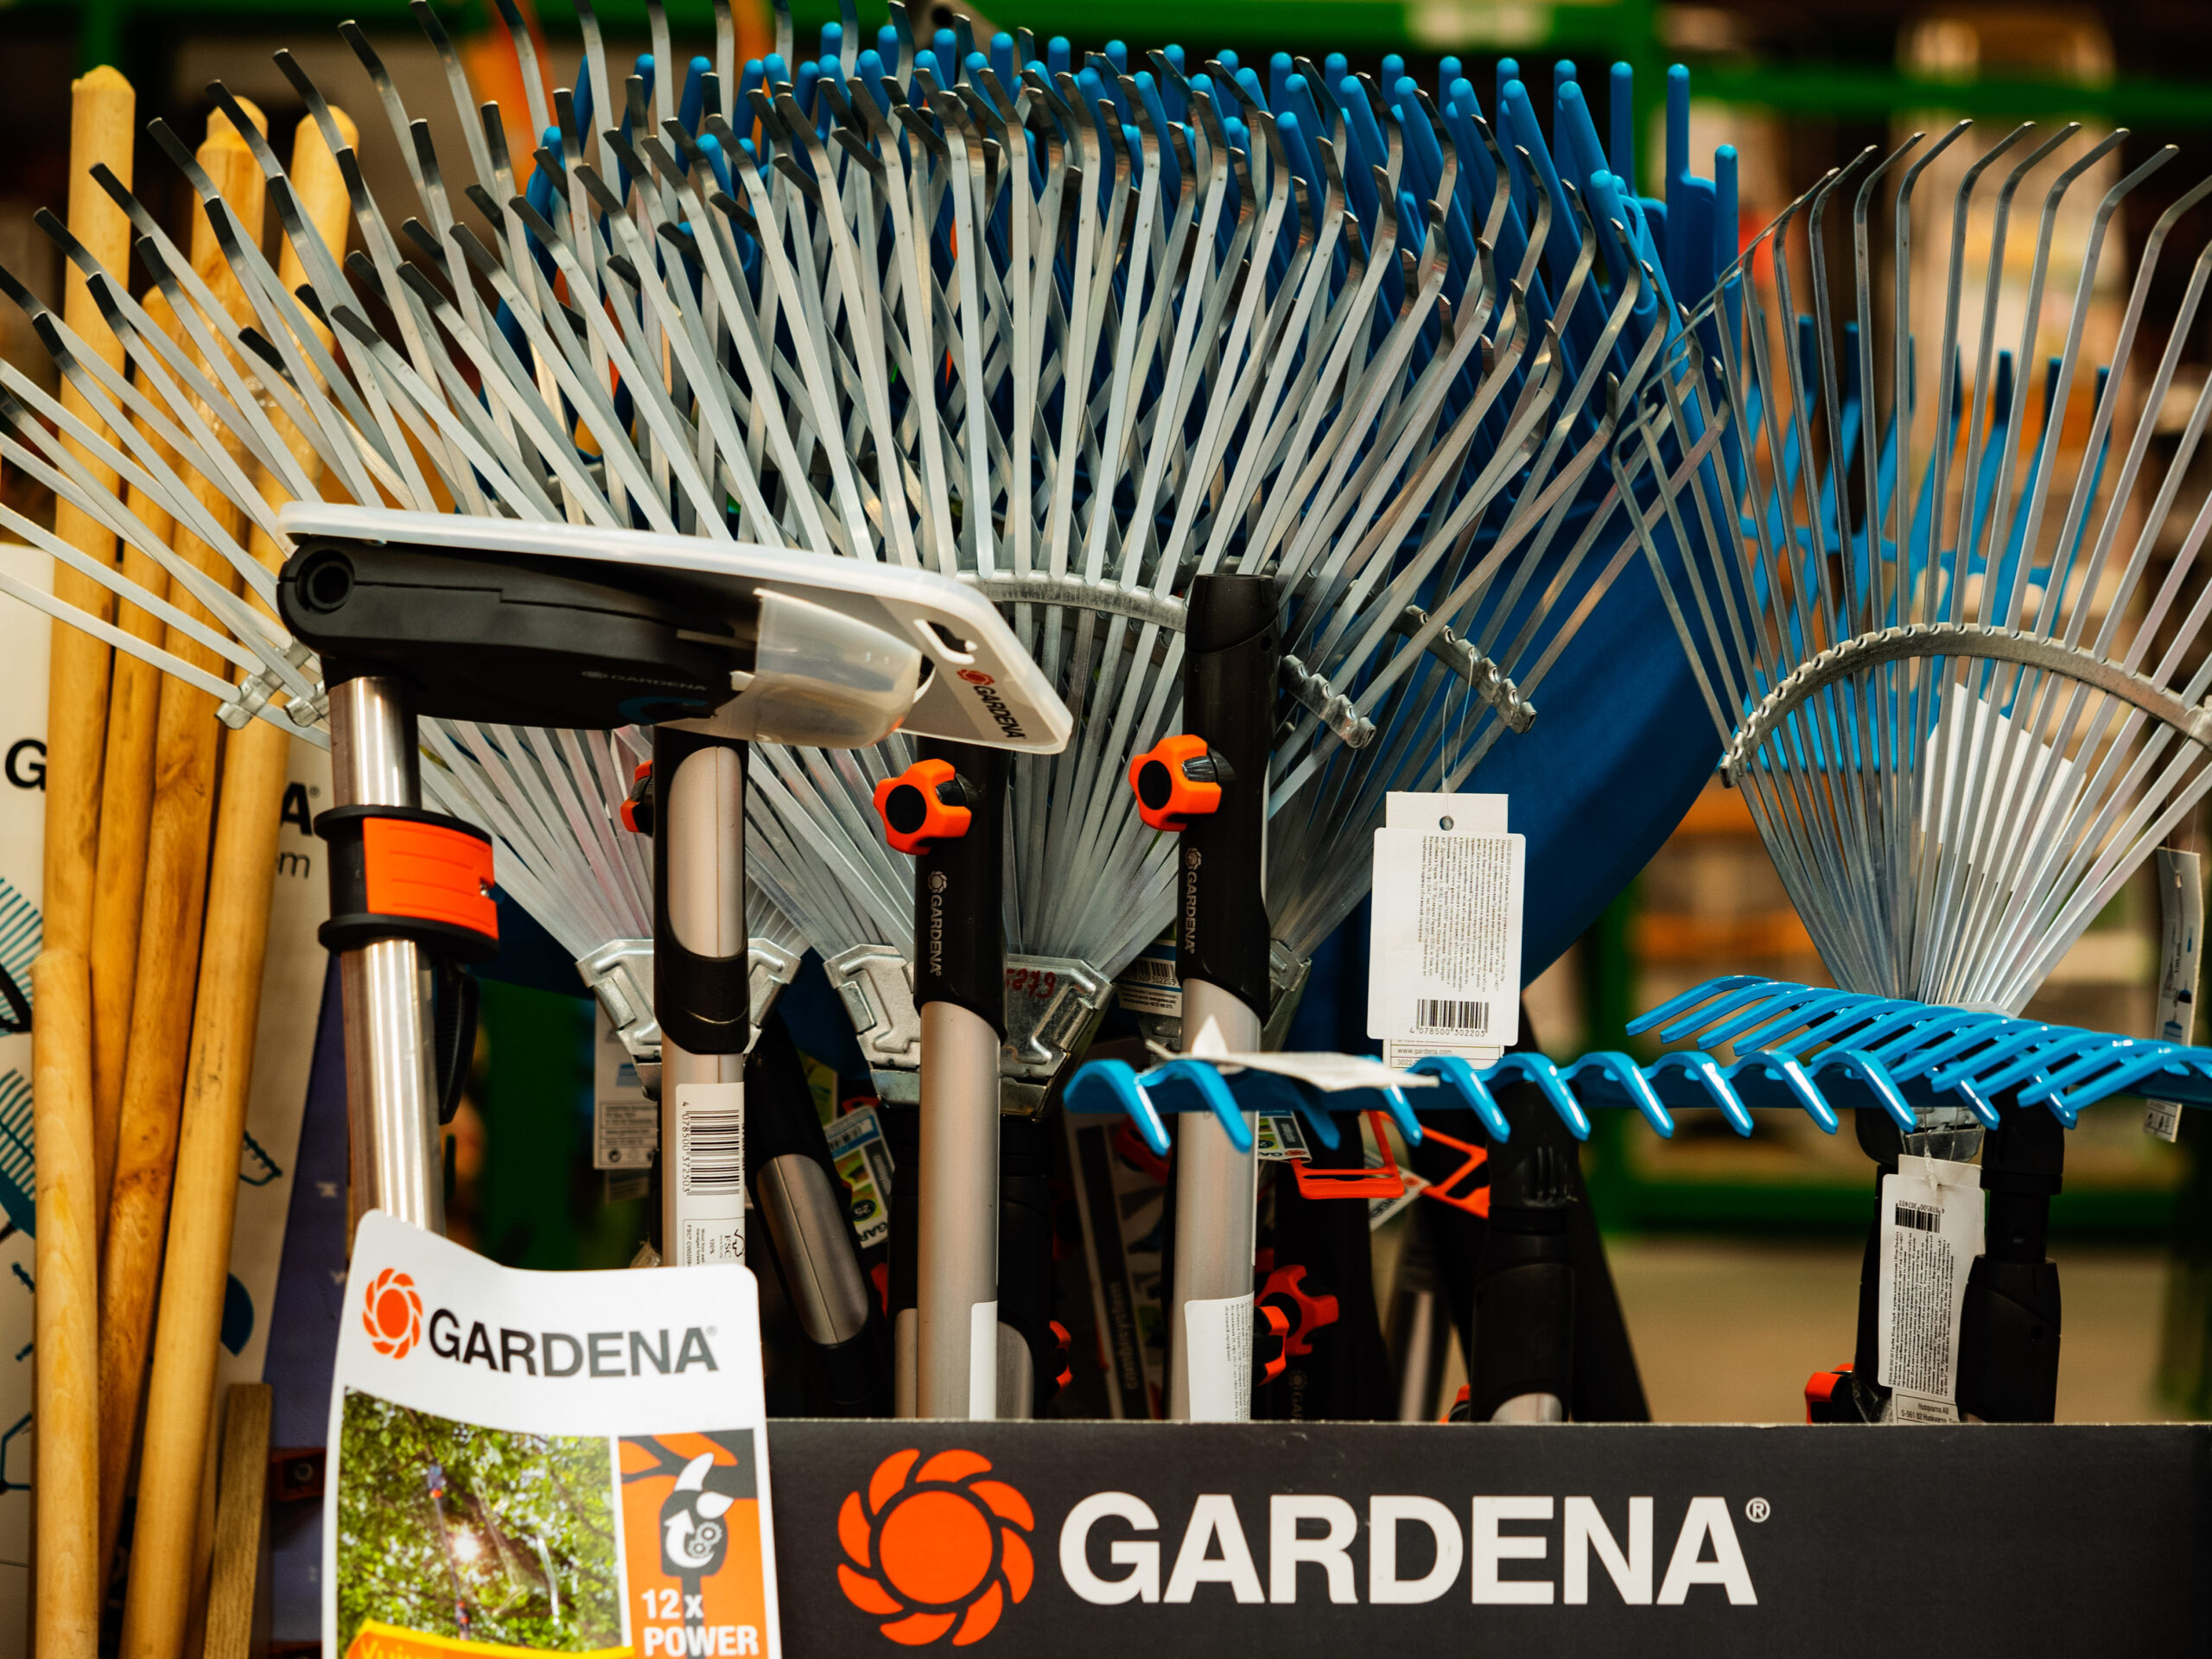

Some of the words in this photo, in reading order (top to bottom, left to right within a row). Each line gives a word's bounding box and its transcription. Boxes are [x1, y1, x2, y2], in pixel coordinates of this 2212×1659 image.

[973, 685, 1027, 739] GARDENA
[1454, 1028, 1486, 1037] 302203
[682, 1114, 690, 1150] 078500
[682, 1154, 690, 1192] 372503
[644, 1624, 760, 1656] POWER
